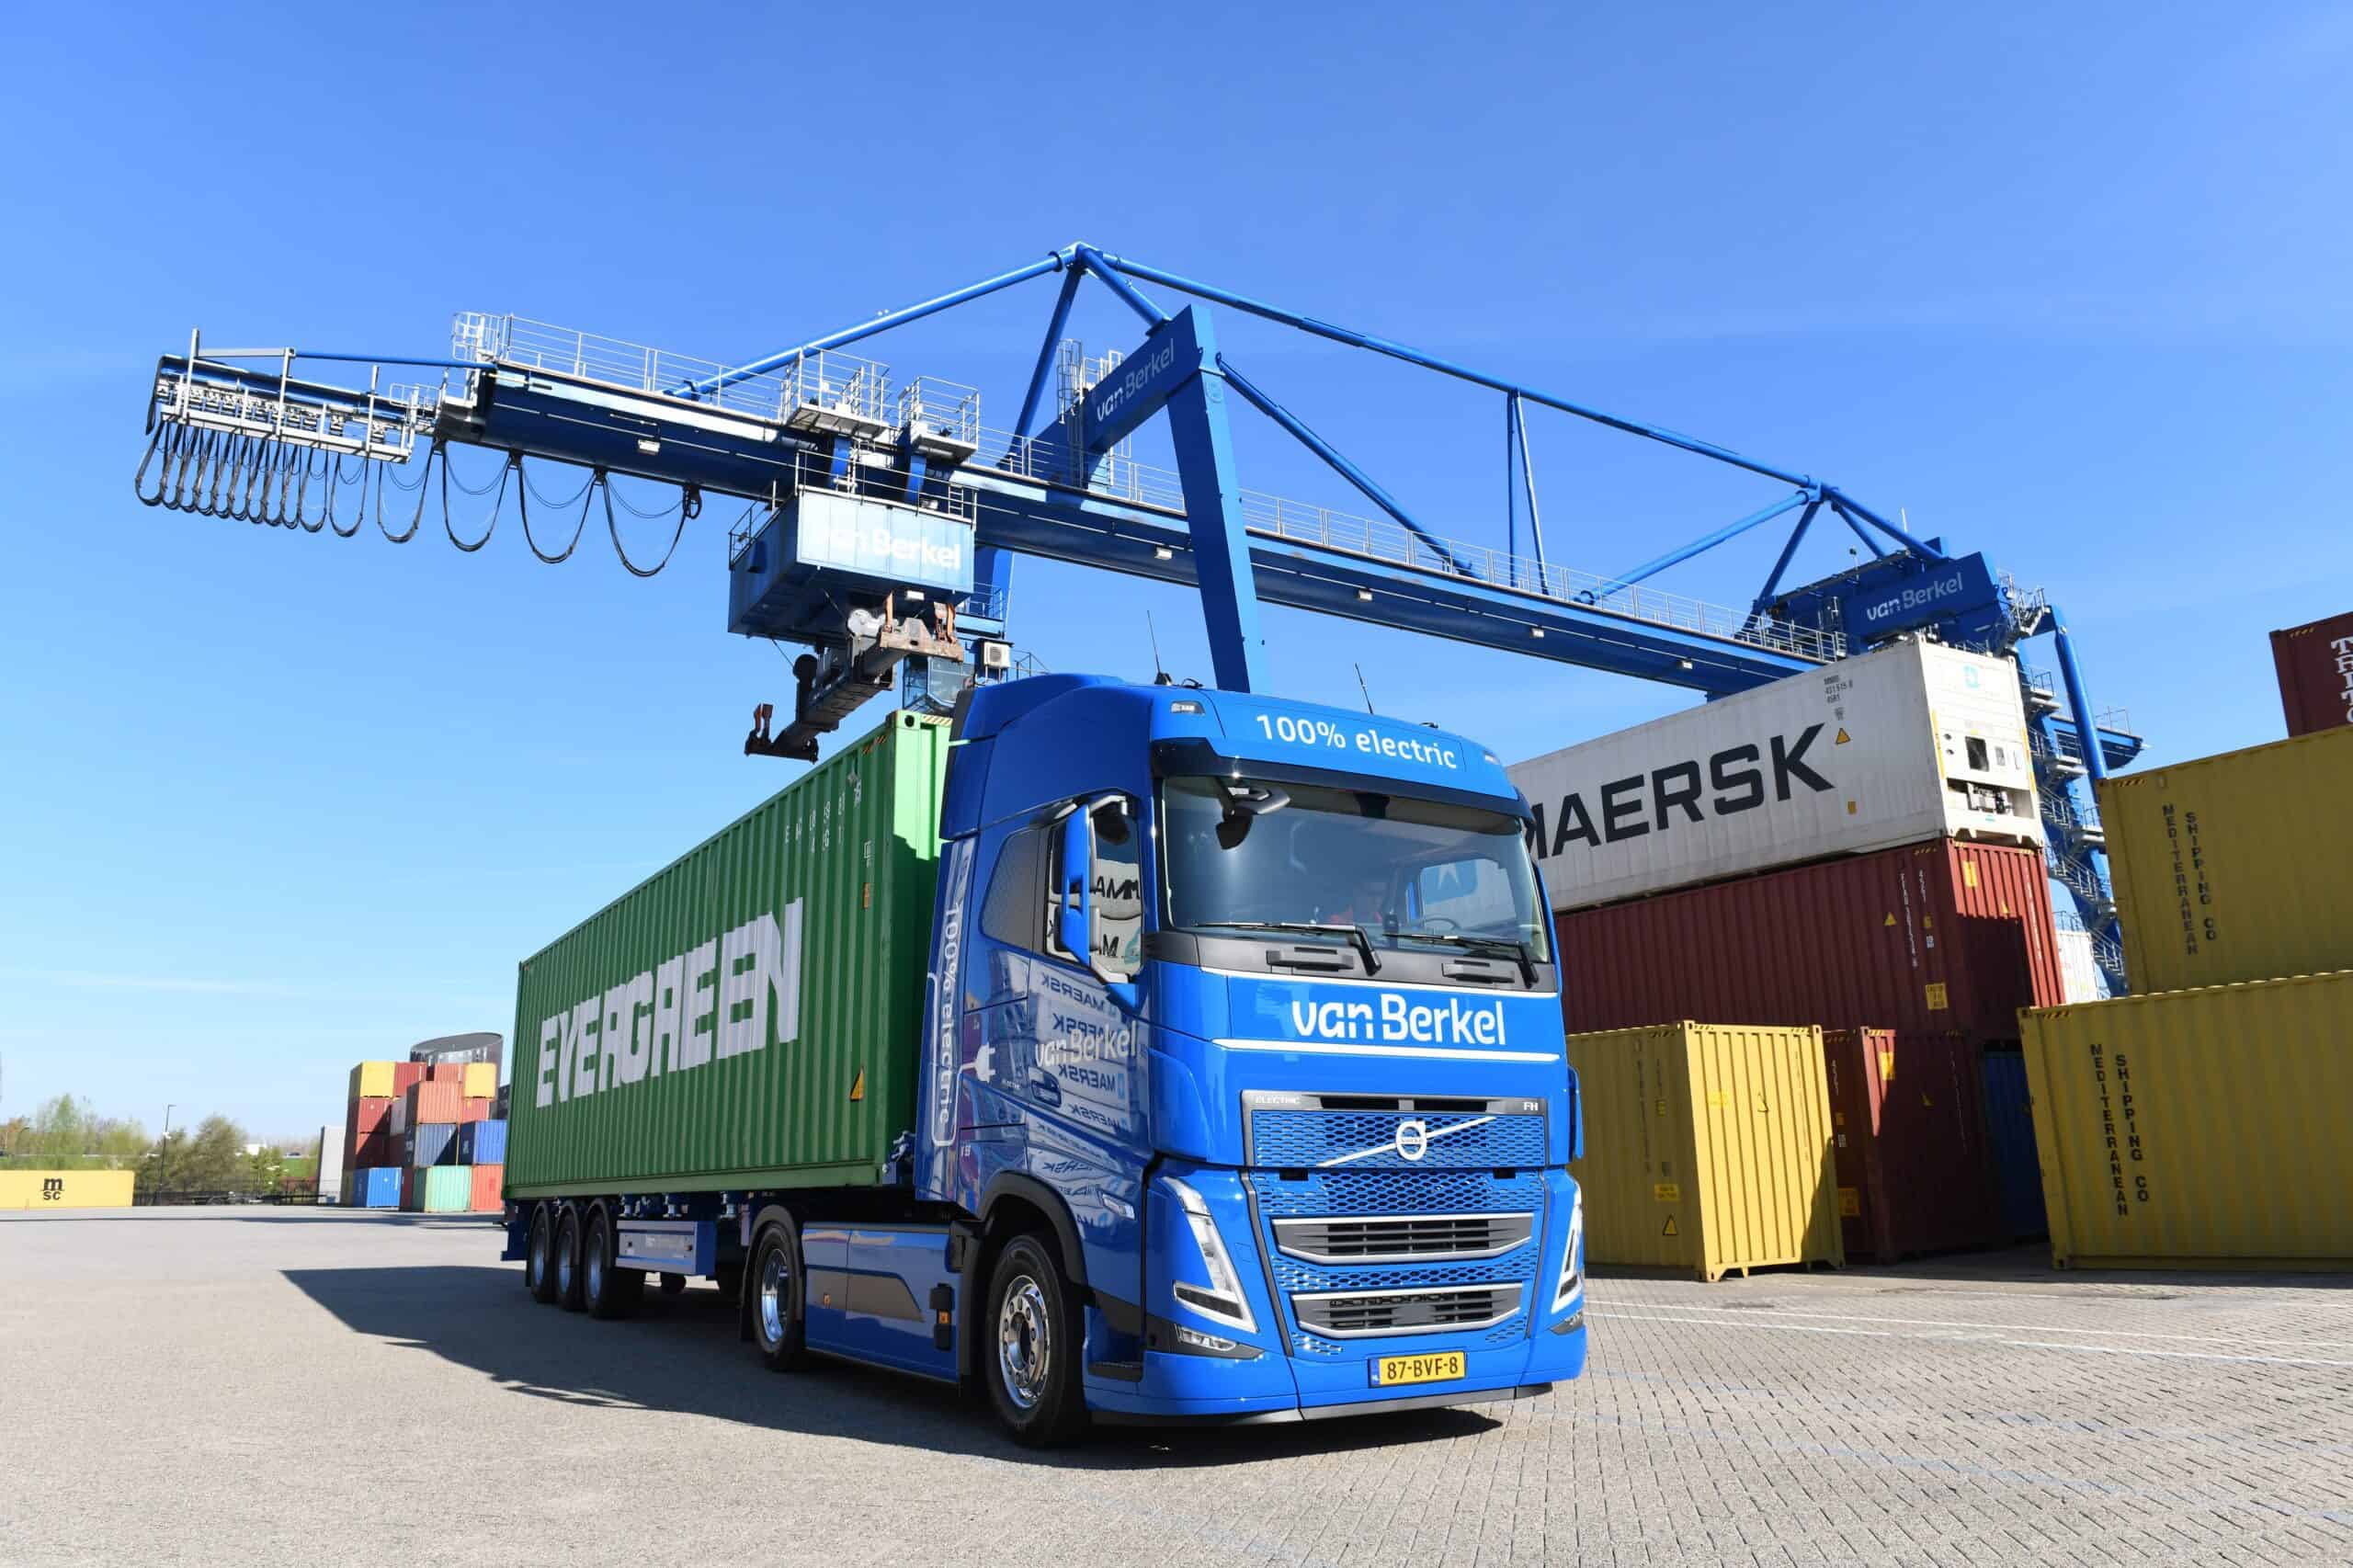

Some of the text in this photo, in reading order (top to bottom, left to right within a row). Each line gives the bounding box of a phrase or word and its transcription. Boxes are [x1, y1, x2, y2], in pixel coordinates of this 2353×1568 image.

[1256, 714, 1457, 769] 100% electric
[945, 903, 959, 991] 100%
[536, 897, 803, 1108] EVERGREEN
[1524, 1102, 1539, 1111] FH
[2090, 1043, 2128, 1216] MEDITERRANEAN
[2116, 1054, 2149, 1202] SHIPPING CO
[1387, 1357, 1459, 1381] 87-BVF-8
